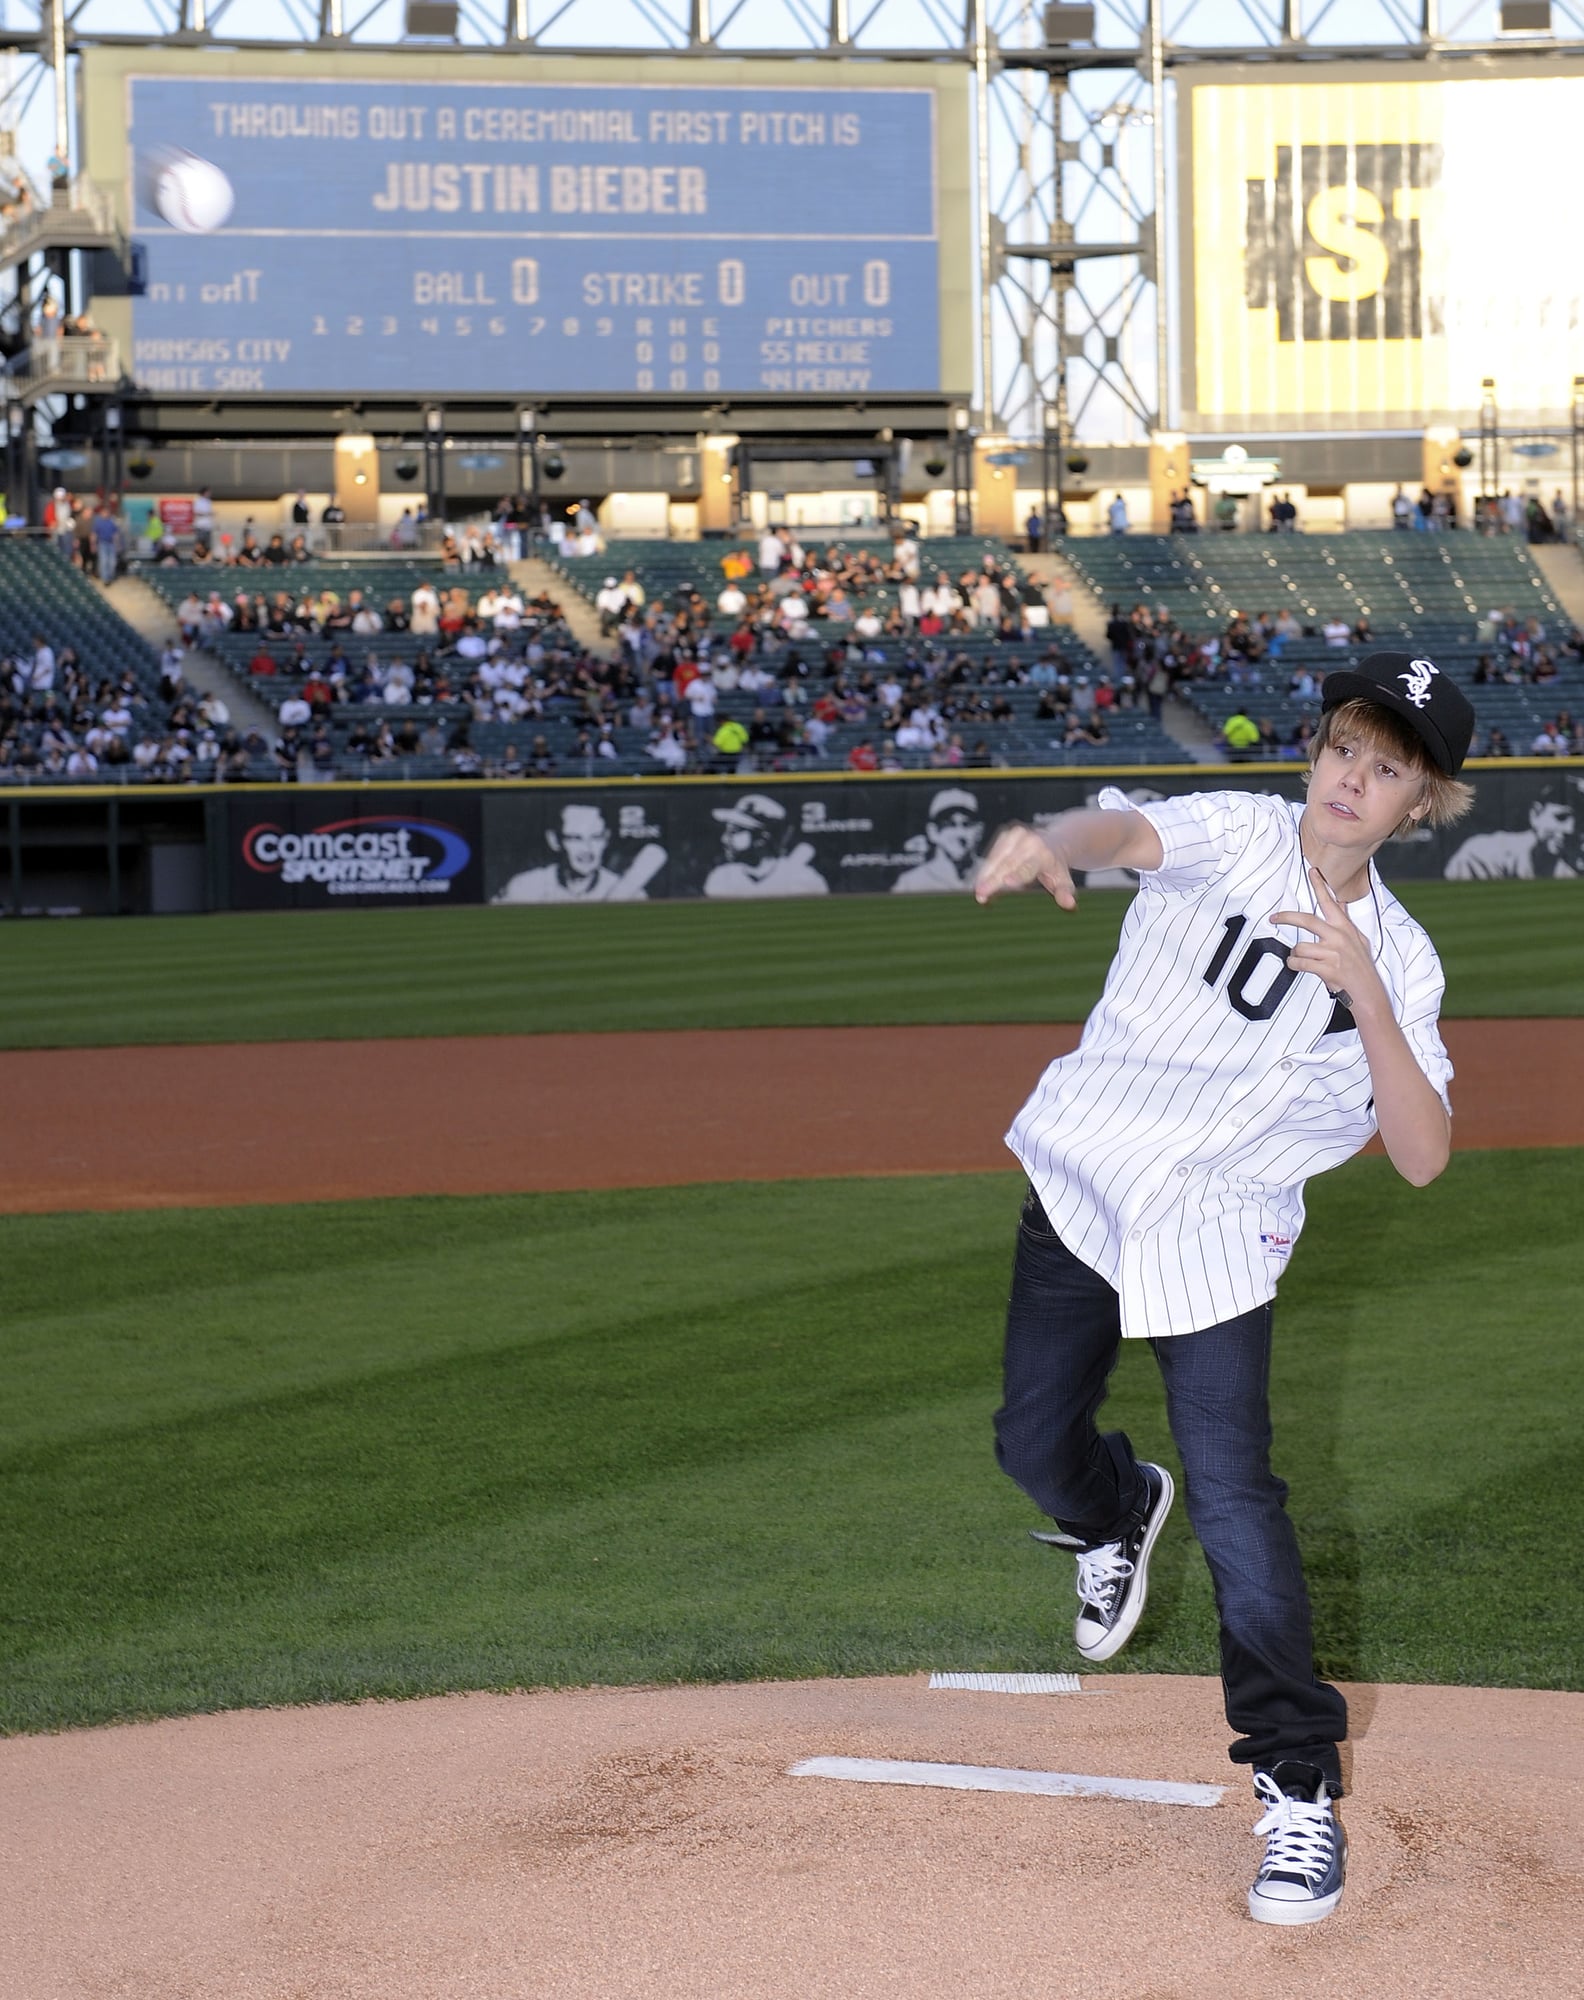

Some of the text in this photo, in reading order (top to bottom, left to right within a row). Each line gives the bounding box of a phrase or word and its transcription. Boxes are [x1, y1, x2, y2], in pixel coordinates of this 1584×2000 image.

[210, 103, 860, 145] THROWING OUT A CEREMONIAL FIRST PITCH IS
[372, 162, 707, 214] JUSTIN BIEBER
[415, 257, 890, 307] BALL 0 STRIKE 0 OUT 0
[312, 315, 893, 337] 1 2 3 4 5 6 7 8 9 R H E PITCHERS
[135, 339, 230, 361] KANSAS
[237, 339, 291, 362] CITY
[637, 341, 653, 364] 0
[670, 342, 687, 364] 0
[703, 342, 720, 364] 0
[136, 367, 207, 391] WHITE
[214, 367, 264, 391] SOX
[637, 369, 654, 391] 0
[671, 369, 687, 392] 0
[704, 369, 720, 392] 0
[280, 856, 431, 882] SPORTSNET
[1201, 912, 1303, 1024] 10
